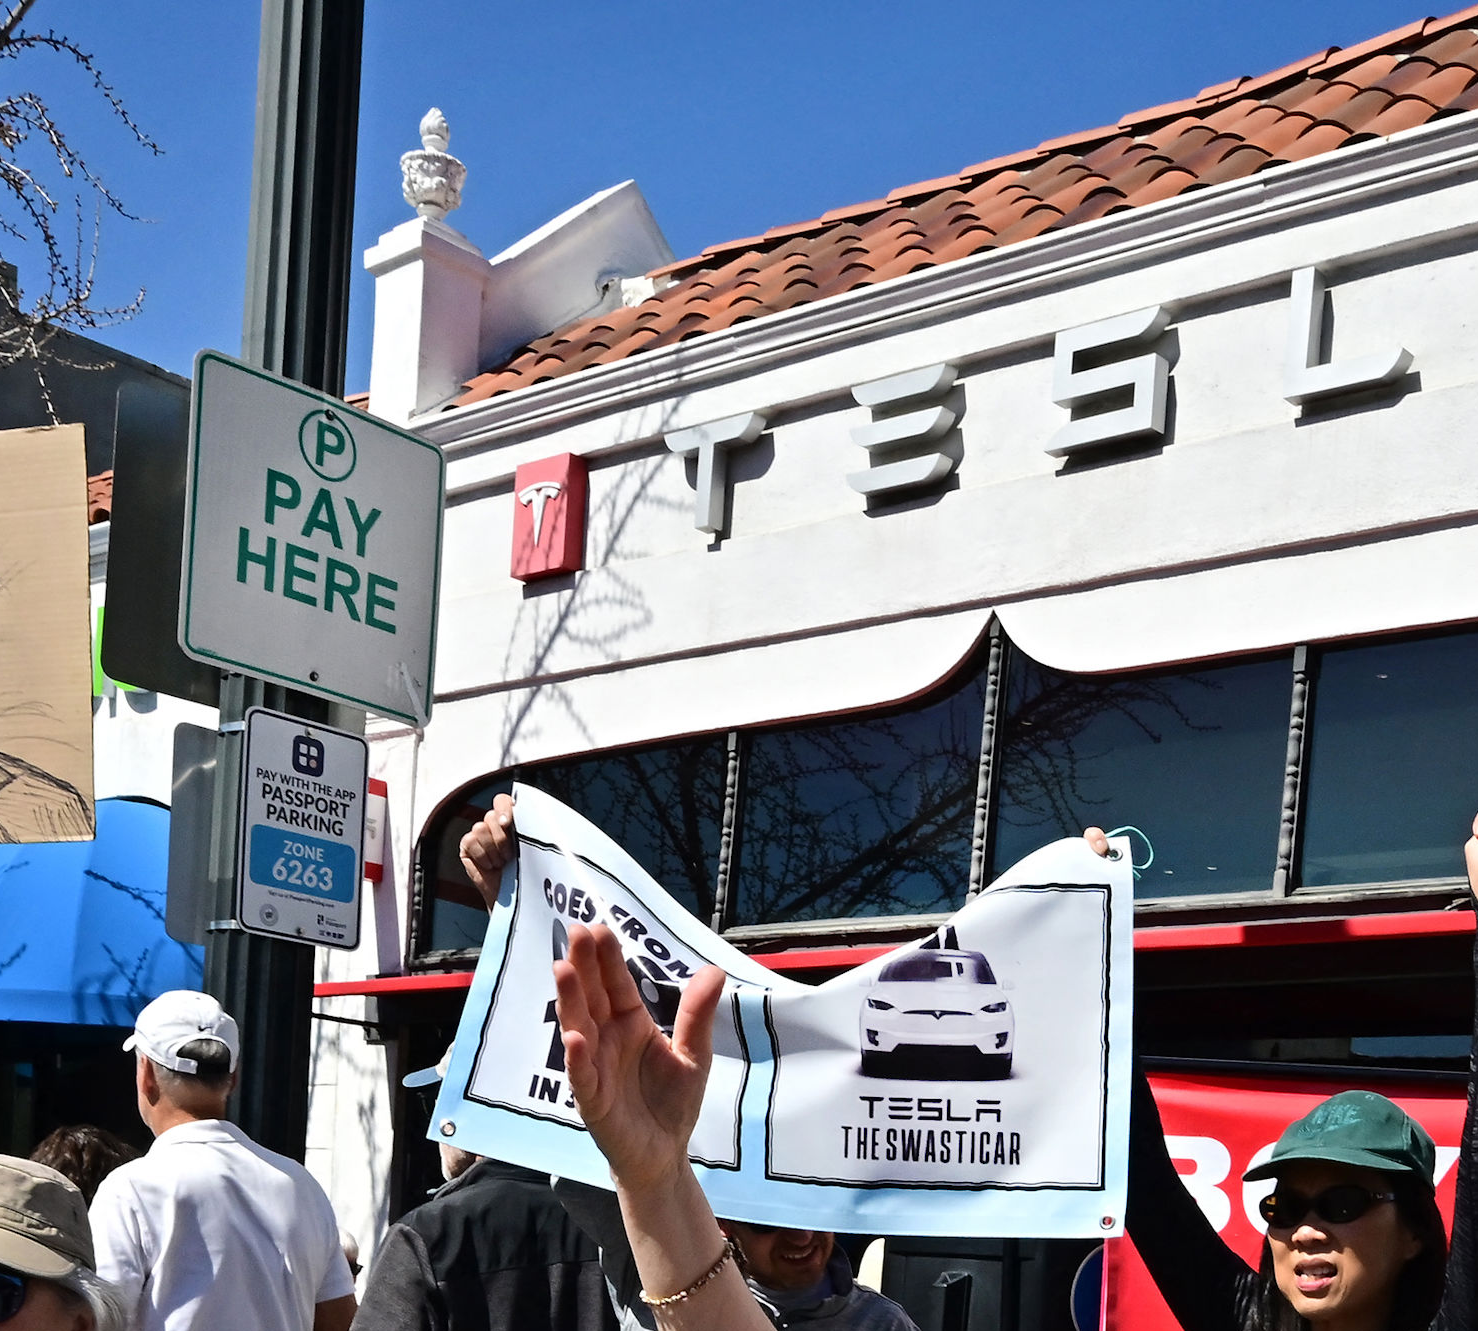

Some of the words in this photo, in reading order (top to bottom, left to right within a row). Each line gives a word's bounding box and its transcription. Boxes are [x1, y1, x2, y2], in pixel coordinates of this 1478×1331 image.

[264, 467, 382, 558] PAY
[236, 526, 399, 635] HERE
[256, 768, 278, 781] PAY
[279, 774, 310, 791] WITH
[312, 782, 333, 797] THE
[334, 788, 357, 802] APP
[262, 783, 350, 819] PASSPORT
[266, 803, 344, 836] PARKING
[283, 840, 325, 863] ZONE
[272, 857, 334, 892] 6263
[543, 877, 597, 924] GOES
[528, 1074, 561, 1104] IN
[859, 1095, 1002, 1123] TESLA
